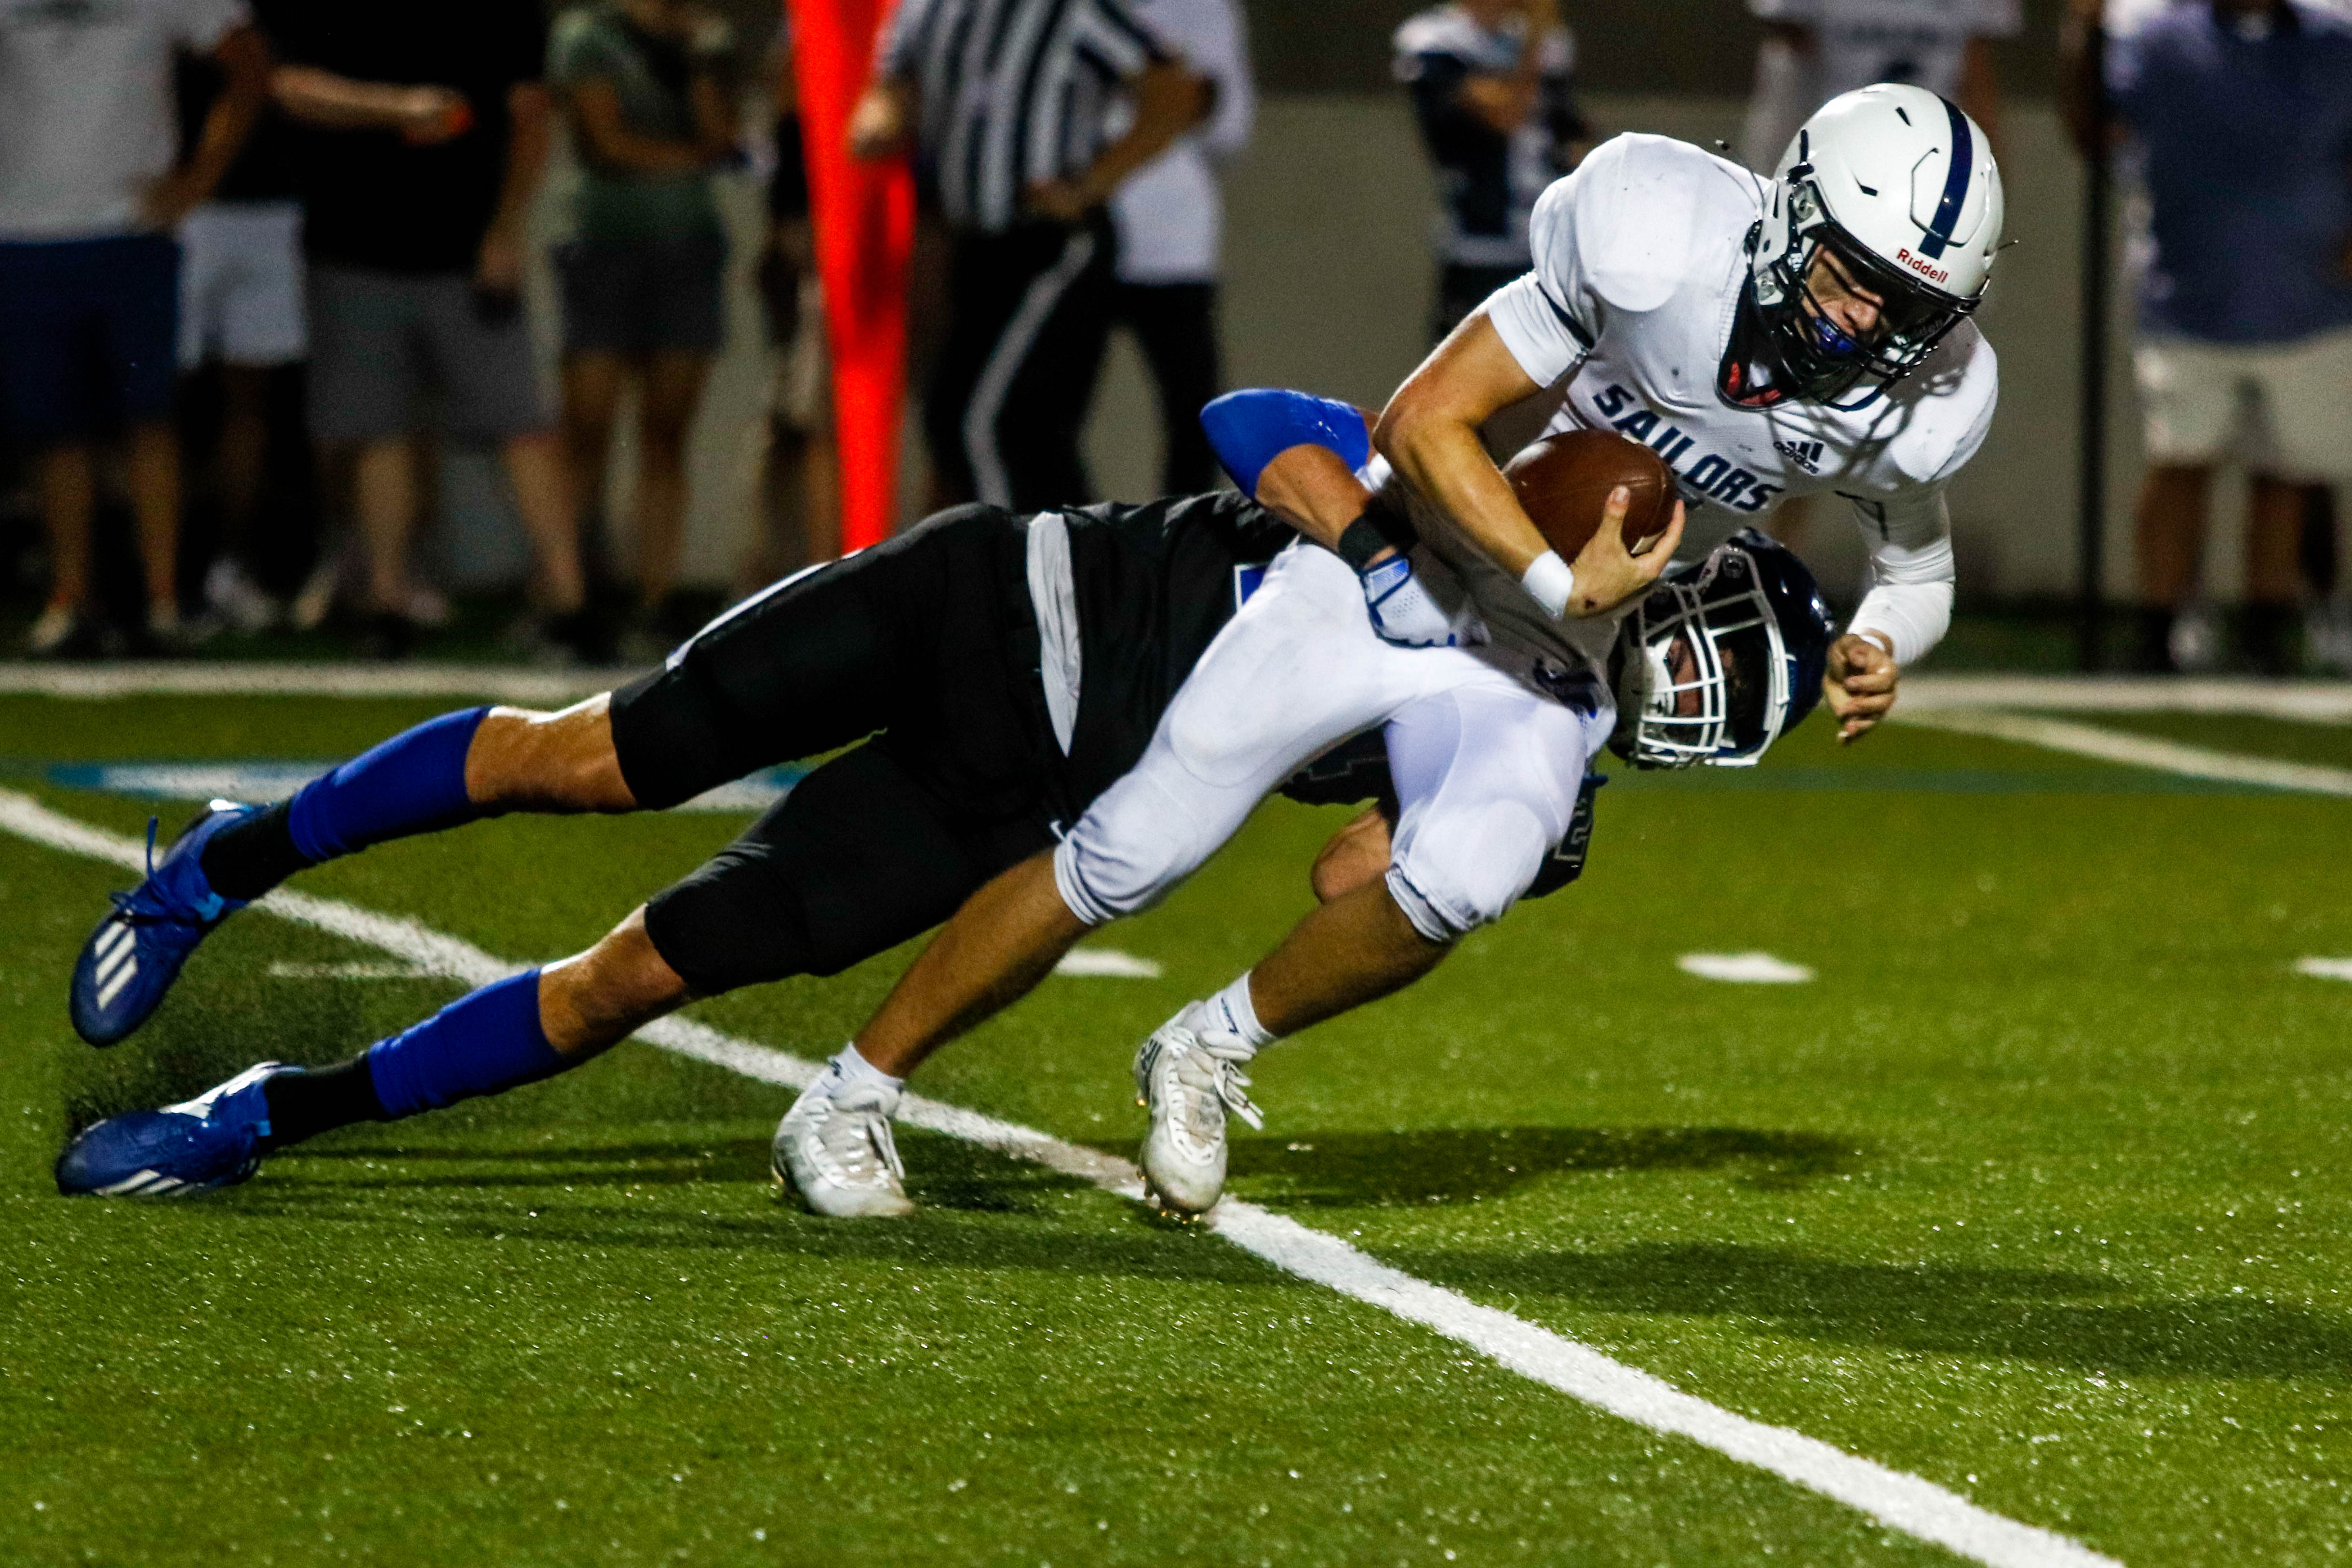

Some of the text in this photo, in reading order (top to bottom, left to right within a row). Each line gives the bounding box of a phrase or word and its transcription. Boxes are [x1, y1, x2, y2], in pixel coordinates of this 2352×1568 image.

[1896, 248, 1949, 283] Riddell
[1592, 384, 1784, 511] SAILORS
[1773, 441, 1819, 474] adidas
